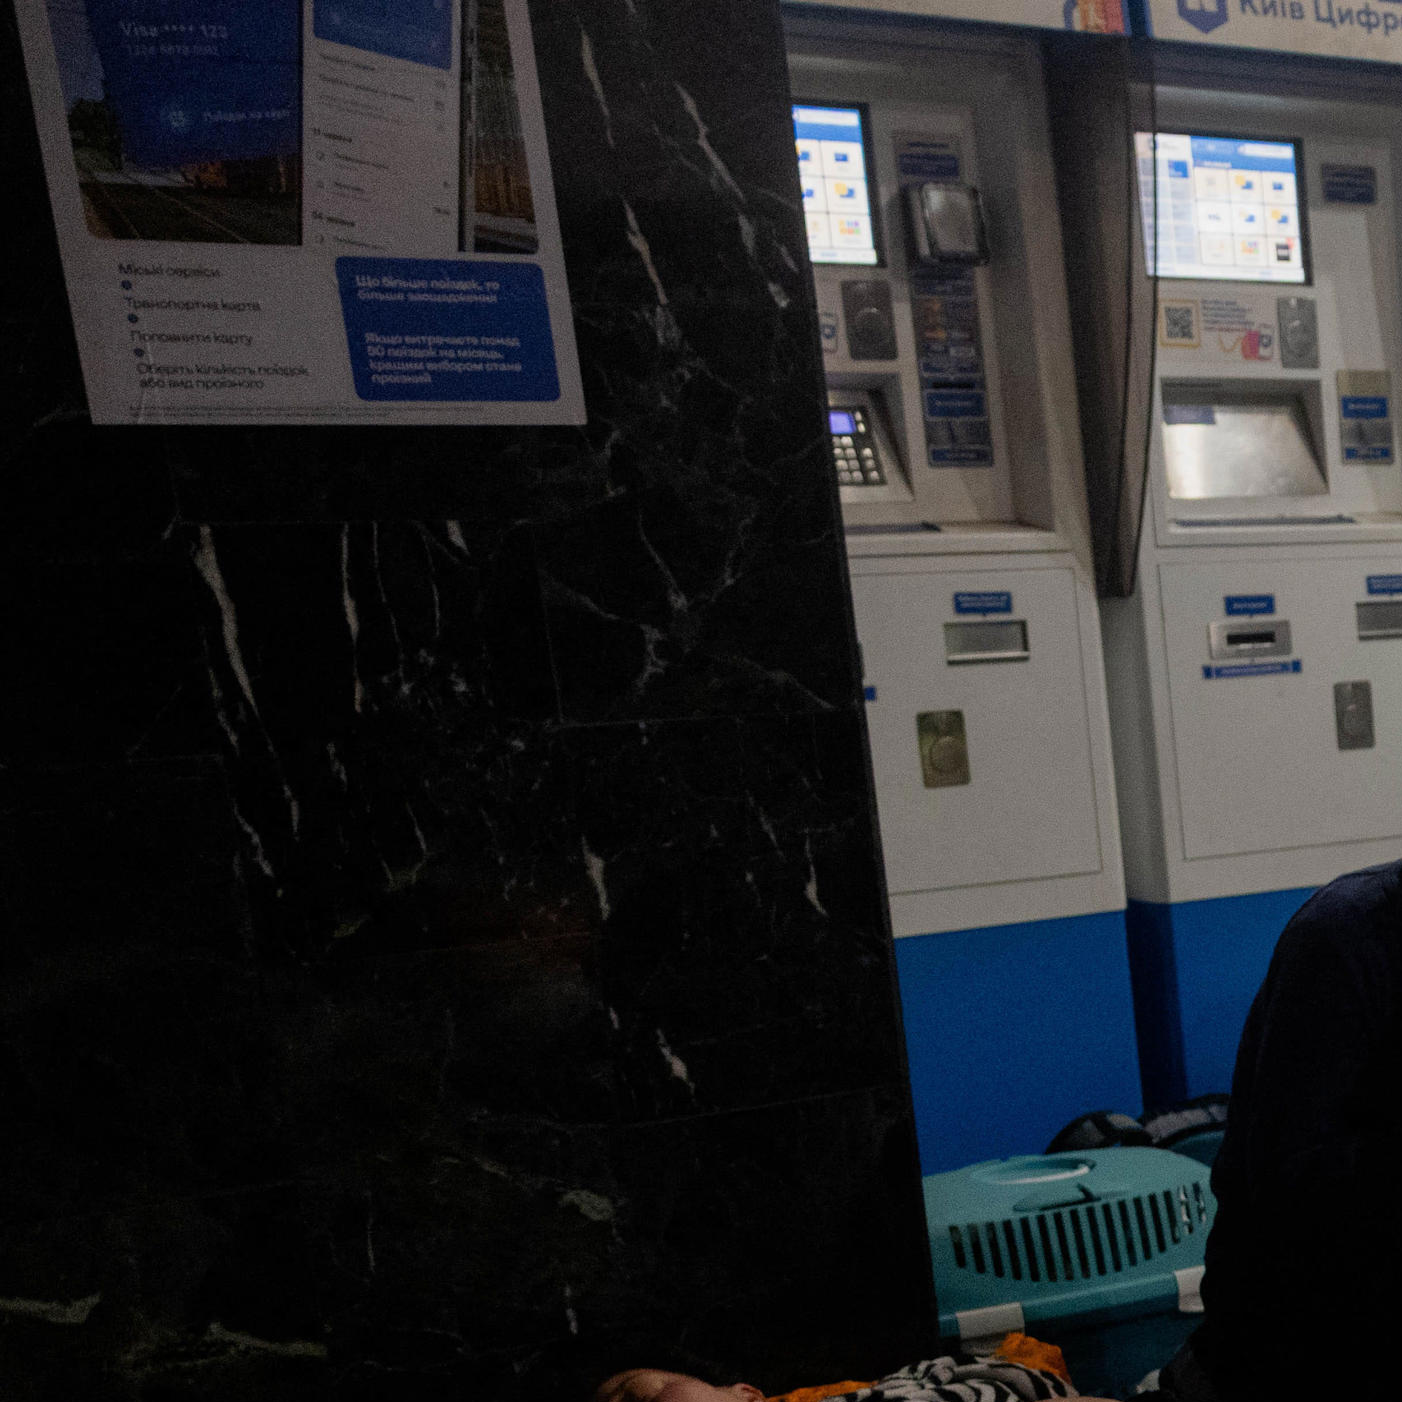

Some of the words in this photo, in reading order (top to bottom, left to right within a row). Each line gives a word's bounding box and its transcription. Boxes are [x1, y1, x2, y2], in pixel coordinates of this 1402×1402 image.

[118, 263, 163, 277] Міські
[165, 265, 221, 279] сервіси
[123, 297, 218, 311] Транспортна
[220, 298, 261, 312] карта
[130, 330, 211, 343] Поповнити
[213, 331, 253, 346] карту
[136, 362, 193, 375] Оберіть
[195, 363, 256, 375] кількість
[139, 377, 165, 388] або
